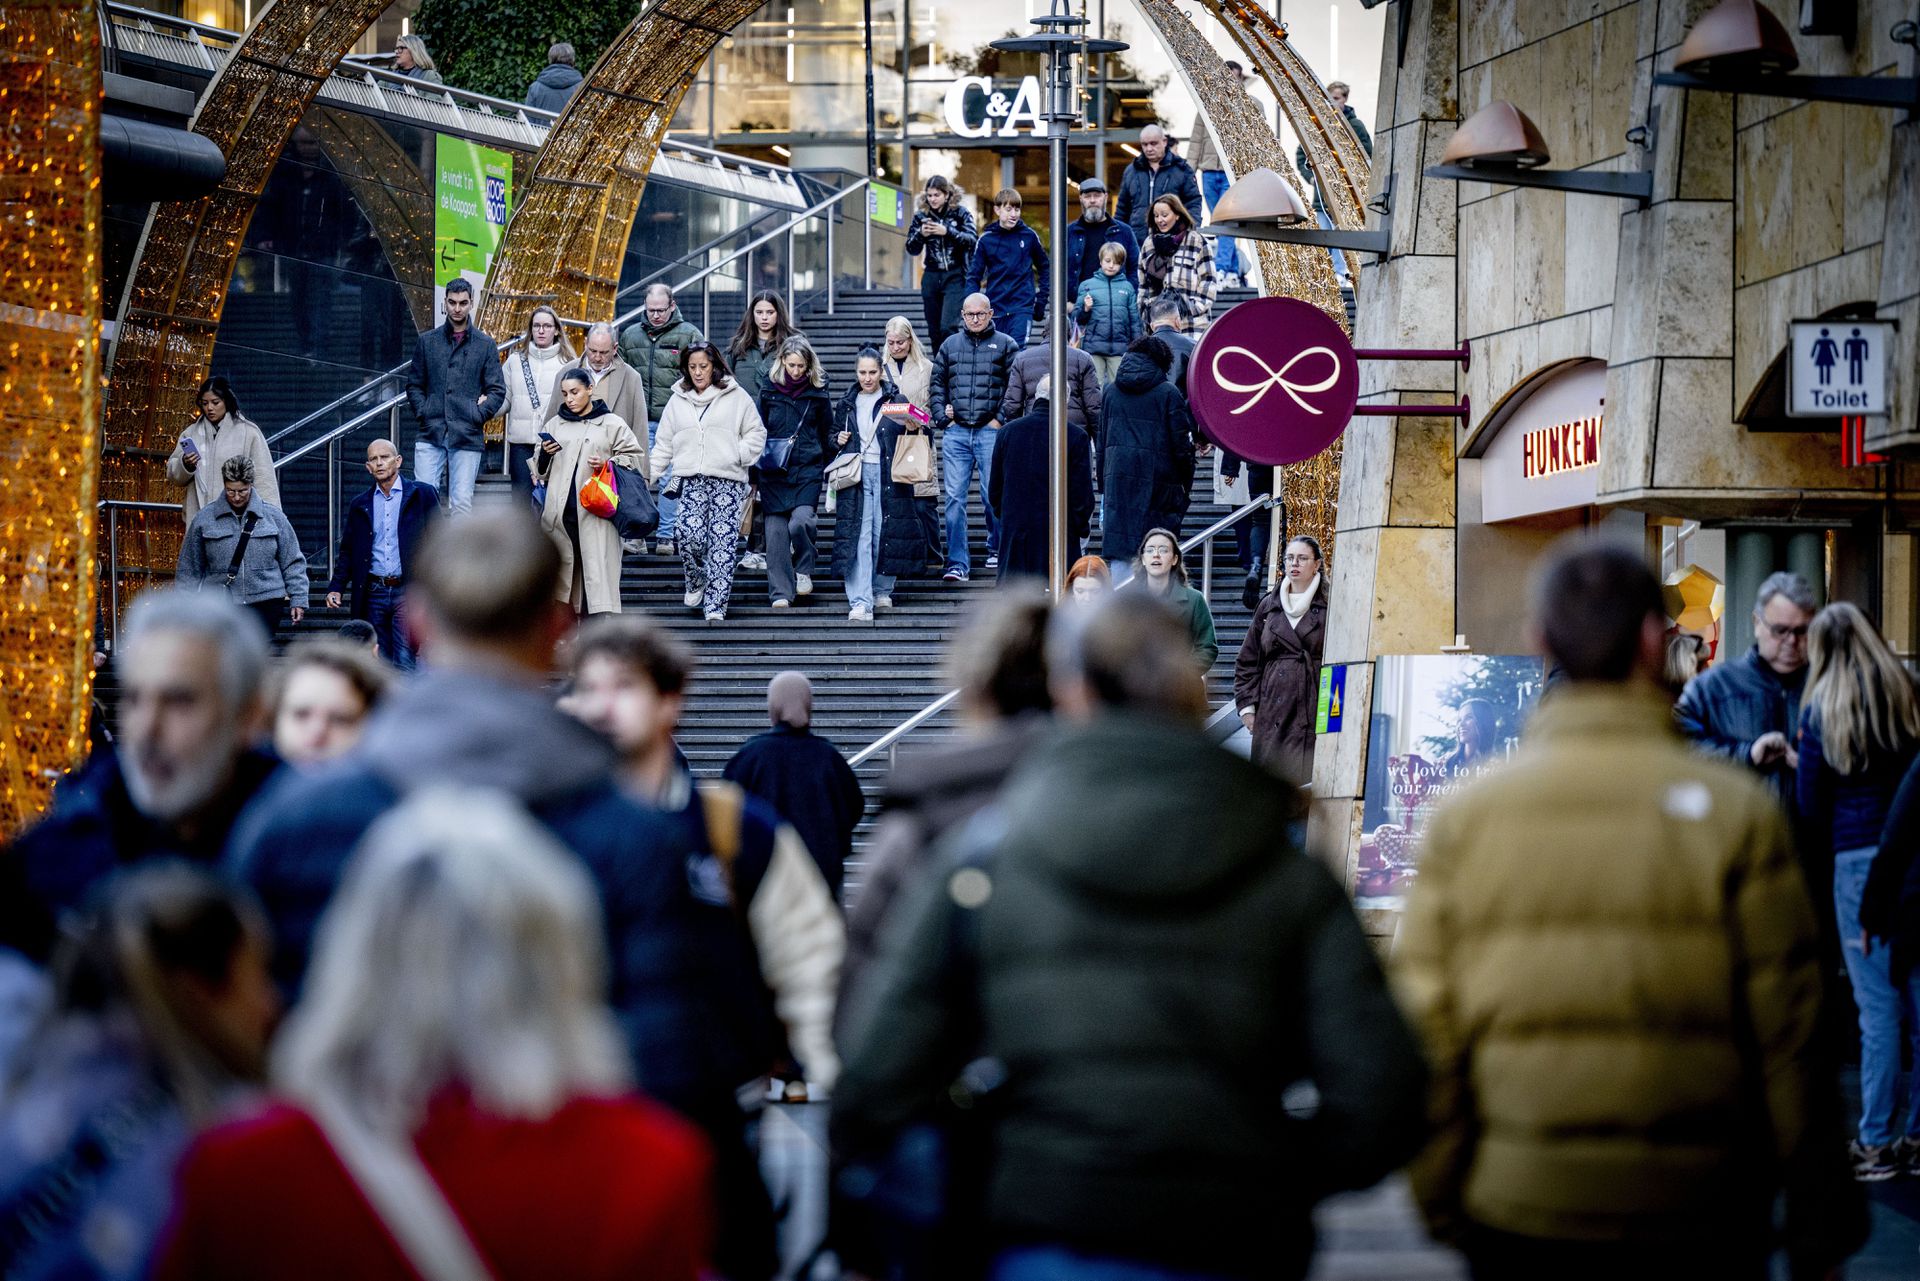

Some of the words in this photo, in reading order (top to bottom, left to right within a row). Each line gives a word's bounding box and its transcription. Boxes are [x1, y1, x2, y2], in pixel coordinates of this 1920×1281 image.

[944, 75, 1048, 138] C&A
[486, 178, 505, 201] KOOP
[441, 192, 449, 209] de
[486, 200, 506, 224] GOOT
[1810, 389, 1868, 408] Toilet
[1523, 415, 1603, 478] HUNKEM
[1387, 764, 1409, 777] we
[1414, 762, 1447, 778] love
[1453, 764, 1470, 778] to
[1393, 783, 1422, 795] our
